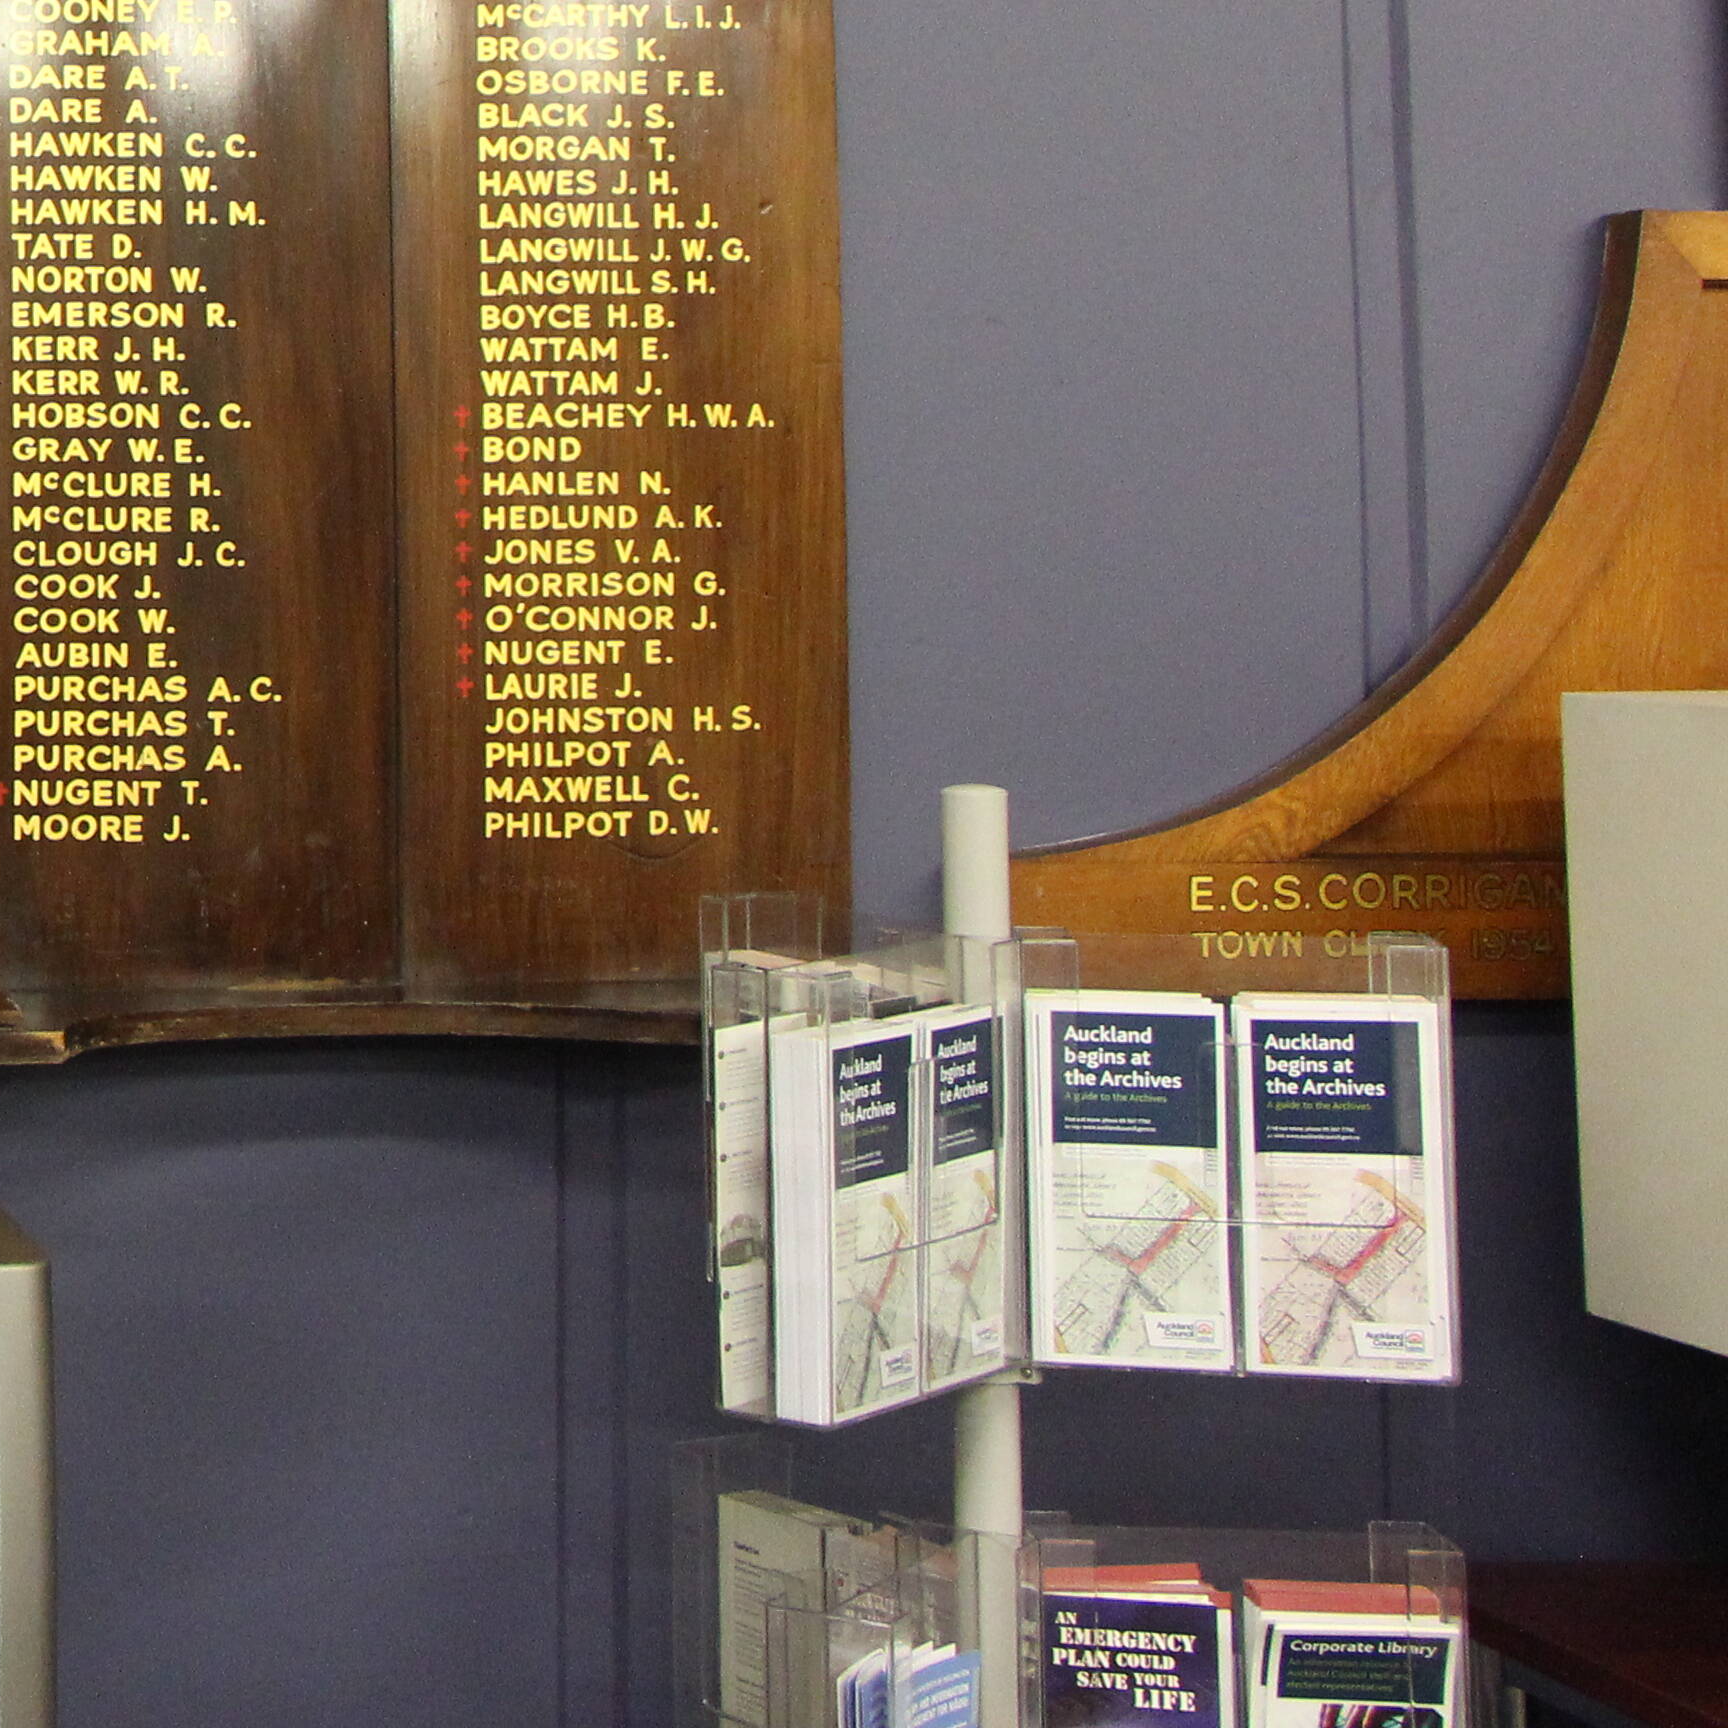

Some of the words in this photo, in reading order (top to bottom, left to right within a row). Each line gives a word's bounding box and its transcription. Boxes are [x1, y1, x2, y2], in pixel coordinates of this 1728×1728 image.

[477, 37, 620, 61] BROOKS
[637, 39, 665, 61] K.
[478, 136, 630, 161] MORGAN
[649, 137, 676, 161] T.
[12, 233, 95, 258] TATE
[112, 234, 141, 258] D.
[12, 266, 152, 292] NORTON
[171, 268, 207, 291] W.
[12, 302, 183, 327] EMERSON
[206, 303, 237, 326] R.
[483, 437, 582, 462] BOND
[485, 572, 675, 596] MORRISON
[693, 571, 725, 594] G.
[486, 604, 674, 631] O'CONNOR
[16, 643, 128, 667] AUBIN
[148, 643, 177, 667] E.
[14, 779, 162, 805] NUGENT
[181, 781, 208, 804] T.
[485, 776, 649, 802] MAXWELL
[668, 774, 699, 800] C.
[14, 814, 143, 841] MOORE
[164, 816, 190, 840] J.
[1192, 932, 1303, 959] TOWN
[1064, 1025, 1152, 1043] Auckland
[1265, 1033, 1354, 1051] Auckland
[1065, 1047, 1126, 1068] begins
[1131, 1051, 1151, 1065] at
[1266, 1056, 1328, 1076] begins
[1333, 1059, 1354, 1073] at
[1064, 1069, 1096, 1086] the
[1100, 1070, 1182, 1088] Archives
[1266, 1077, 1298, 1094] the
[1302, 1079, 1386, 1096] Archives
[1055, 1611, 1077, 1625] AN
[1059, 1627, 1197, 1654] EMERGENCY
[1290, 1640, 1375, 1654] Corporate
[1378, 1642, 1437, 1658] Library
[1053, 1648, 1110, 1668] PLAN
[1116, 1652, 1175, 1670] COULD
[1077, 1671, 1128, 1690] SAVE
[1135, 1672, 1179, 1688] YOUR
[1134, 1688, 1196, 1712] LIFE
